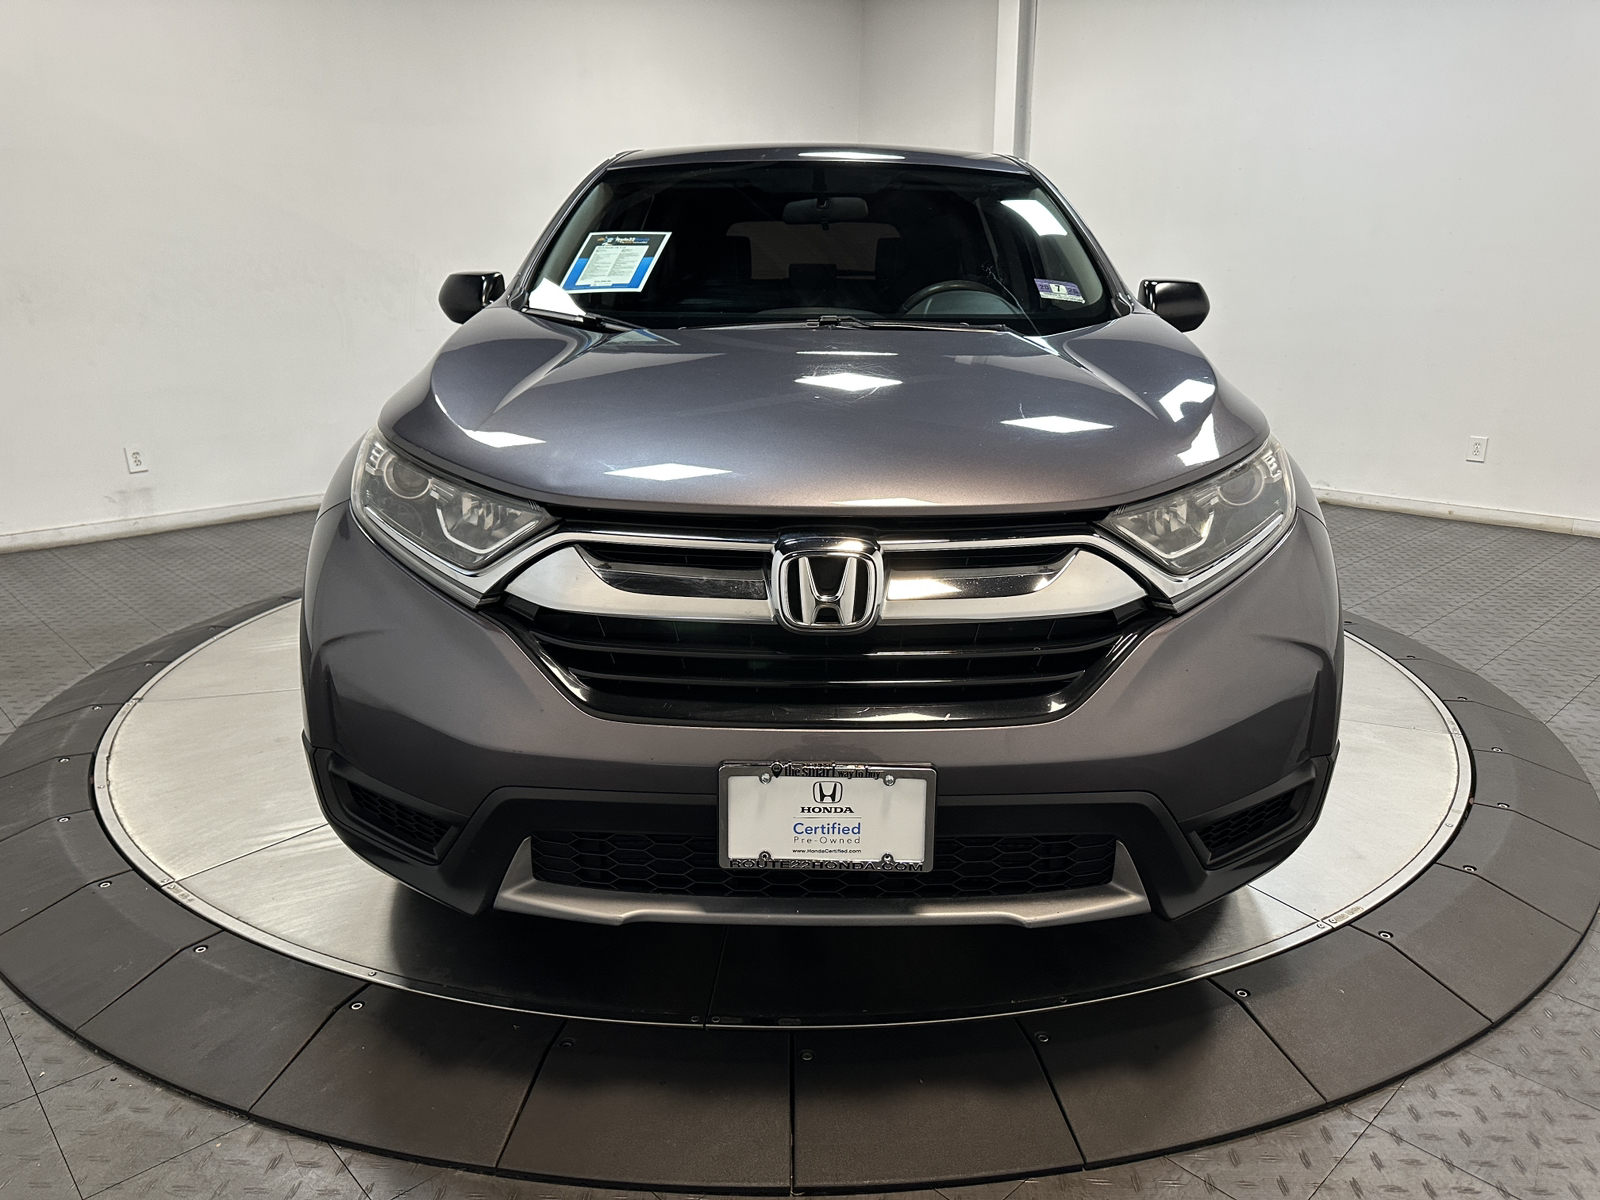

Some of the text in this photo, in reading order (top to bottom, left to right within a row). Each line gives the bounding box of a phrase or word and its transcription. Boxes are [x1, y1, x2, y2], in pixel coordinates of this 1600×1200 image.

[1055, 284, 1060, 292] 7
[784, 763, 801, 777] the
[802, 763, 836, 777] smart
[837, 769, 854, 779] way
[800, 806, 855, 814] HONDA
[793, 822, 861, 835] Certified
[793, 836, 861, 844] Pre-Owned
[729, 859, 924, 872] ROUTE22HONDA.COM
